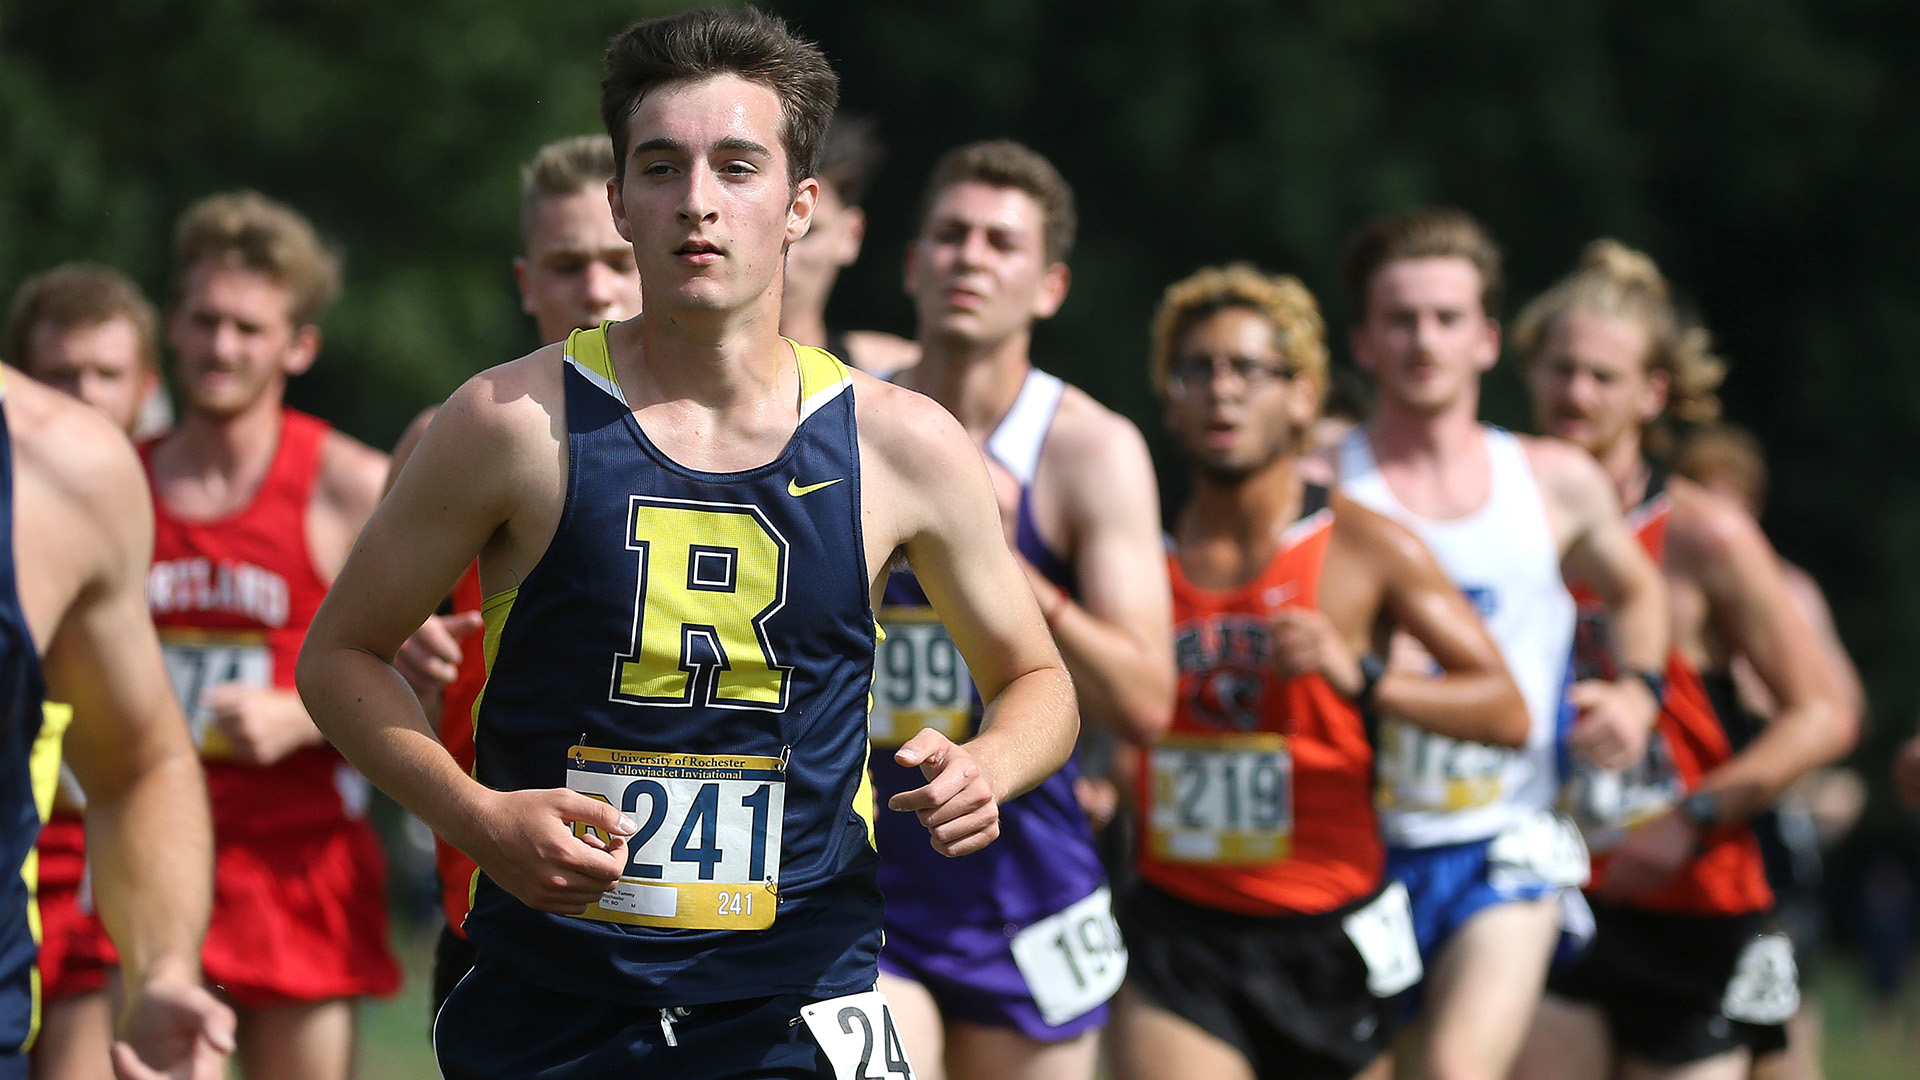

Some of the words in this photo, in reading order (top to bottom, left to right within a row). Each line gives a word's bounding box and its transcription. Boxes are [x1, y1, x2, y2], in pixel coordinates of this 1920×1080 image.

[608, 494, 795, 714] R
[884, 634, 959, 708] 99
[611, 751, 672, 766] University
[674, 756, 687, 766] of
[689, 757, 746, 768] Rochester
[611, 764, 679, 778] Yellowjacket
[680, 768, 743, 780] Invitational
[621, 779, 771, 881] 241
[1175, 760, 1284, 831] 219
[717, 891, 754, 916] 241
